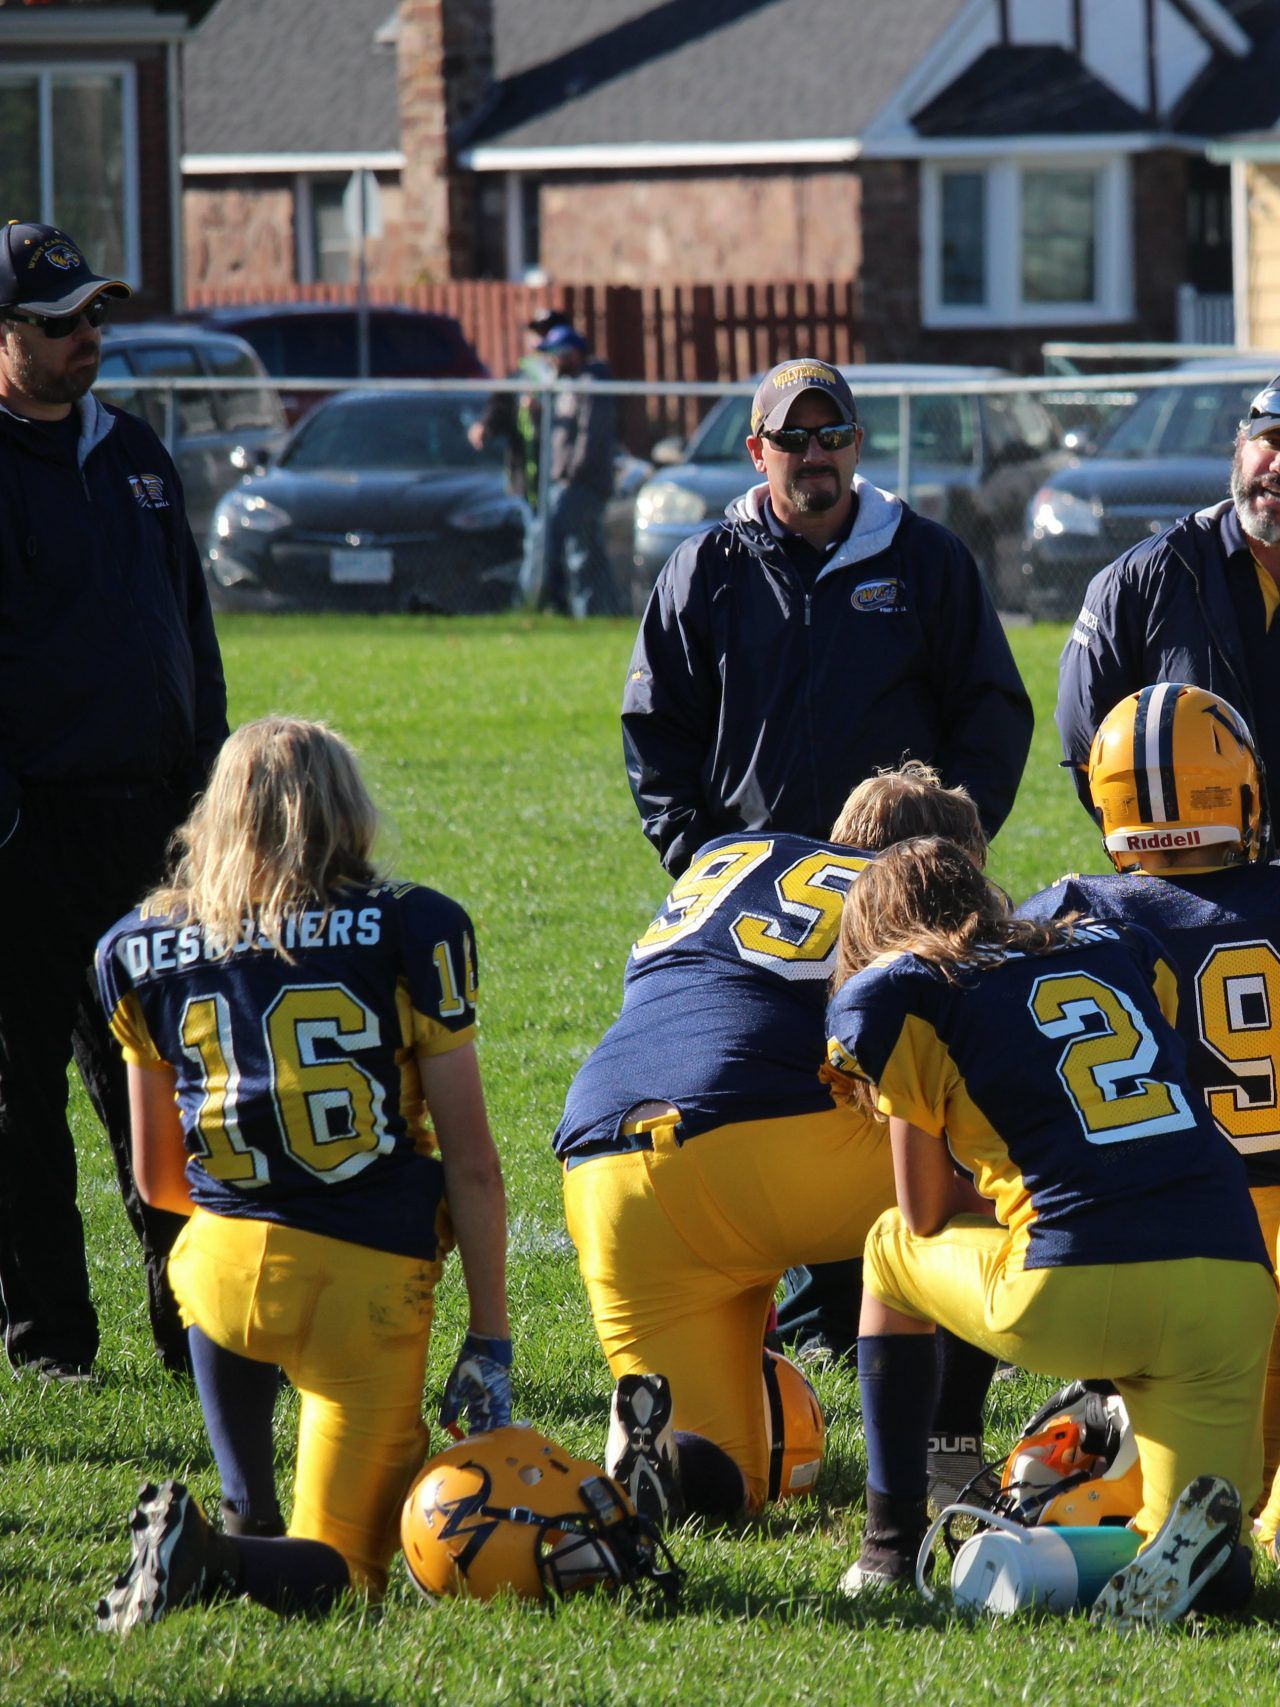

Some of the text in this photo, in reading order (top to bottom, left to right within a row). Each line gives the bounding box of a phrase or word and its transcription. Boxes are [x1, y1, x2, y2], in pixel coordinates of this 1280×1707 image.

[1126, 830, 1201, 851] Riddell
[178, 982, 396, 1189] 16
[1026, 970, 1198, 1145] 2
[927, 1436, 978, 1453] OUR
